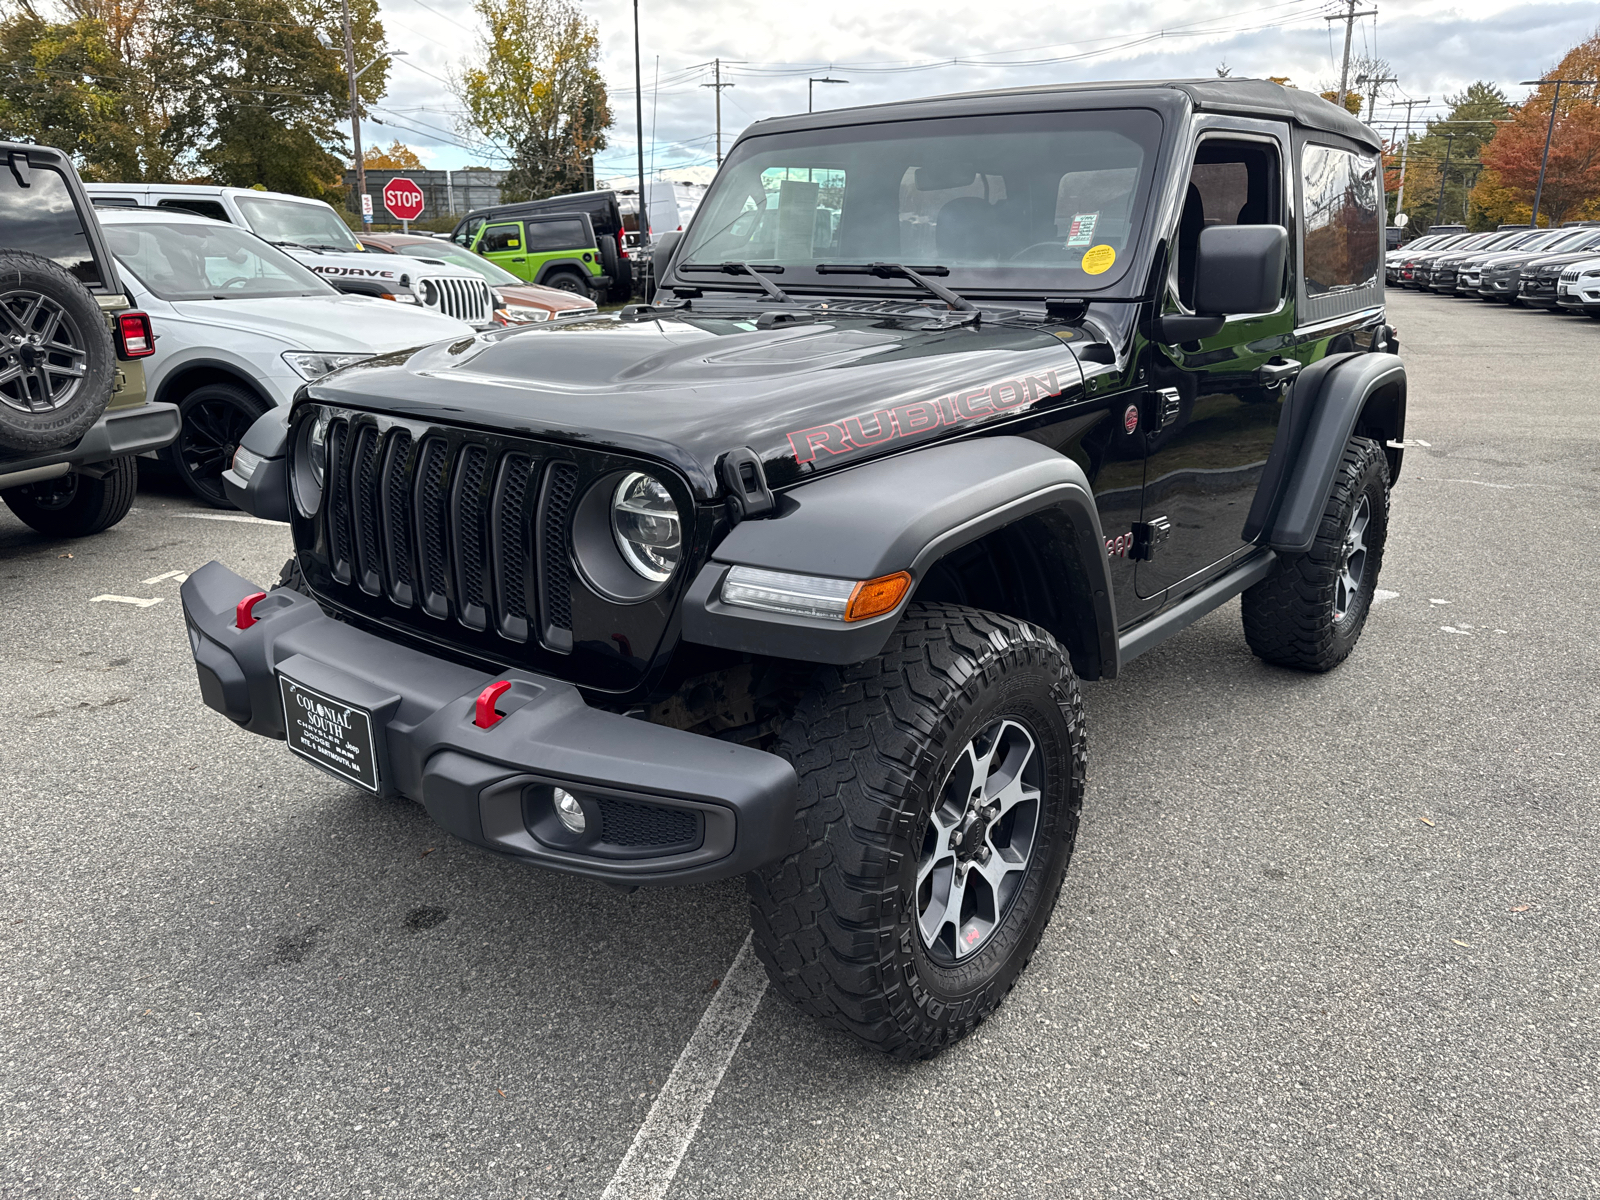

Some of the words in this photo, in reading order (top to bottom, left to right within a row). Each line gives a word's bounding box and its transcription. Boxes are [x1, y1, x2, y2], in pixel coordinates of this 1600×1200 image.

[387, 190, 421, 208] STOP
[306, 265, 394, 278] MOJAVE
[786, 370, 1061, 464] RUBICON
[1103, 531, 1134, 558] eep
[296, 693, 352, 729] COLONIAL
[307, 711, 343, 739] SOUTH
[296, 719, 340, 745] CHRYSLER
[345, 741, 360, 755] Jeep
[303, 730, 331, 748] DODGE
[335, 746, 355, 760] RAM
